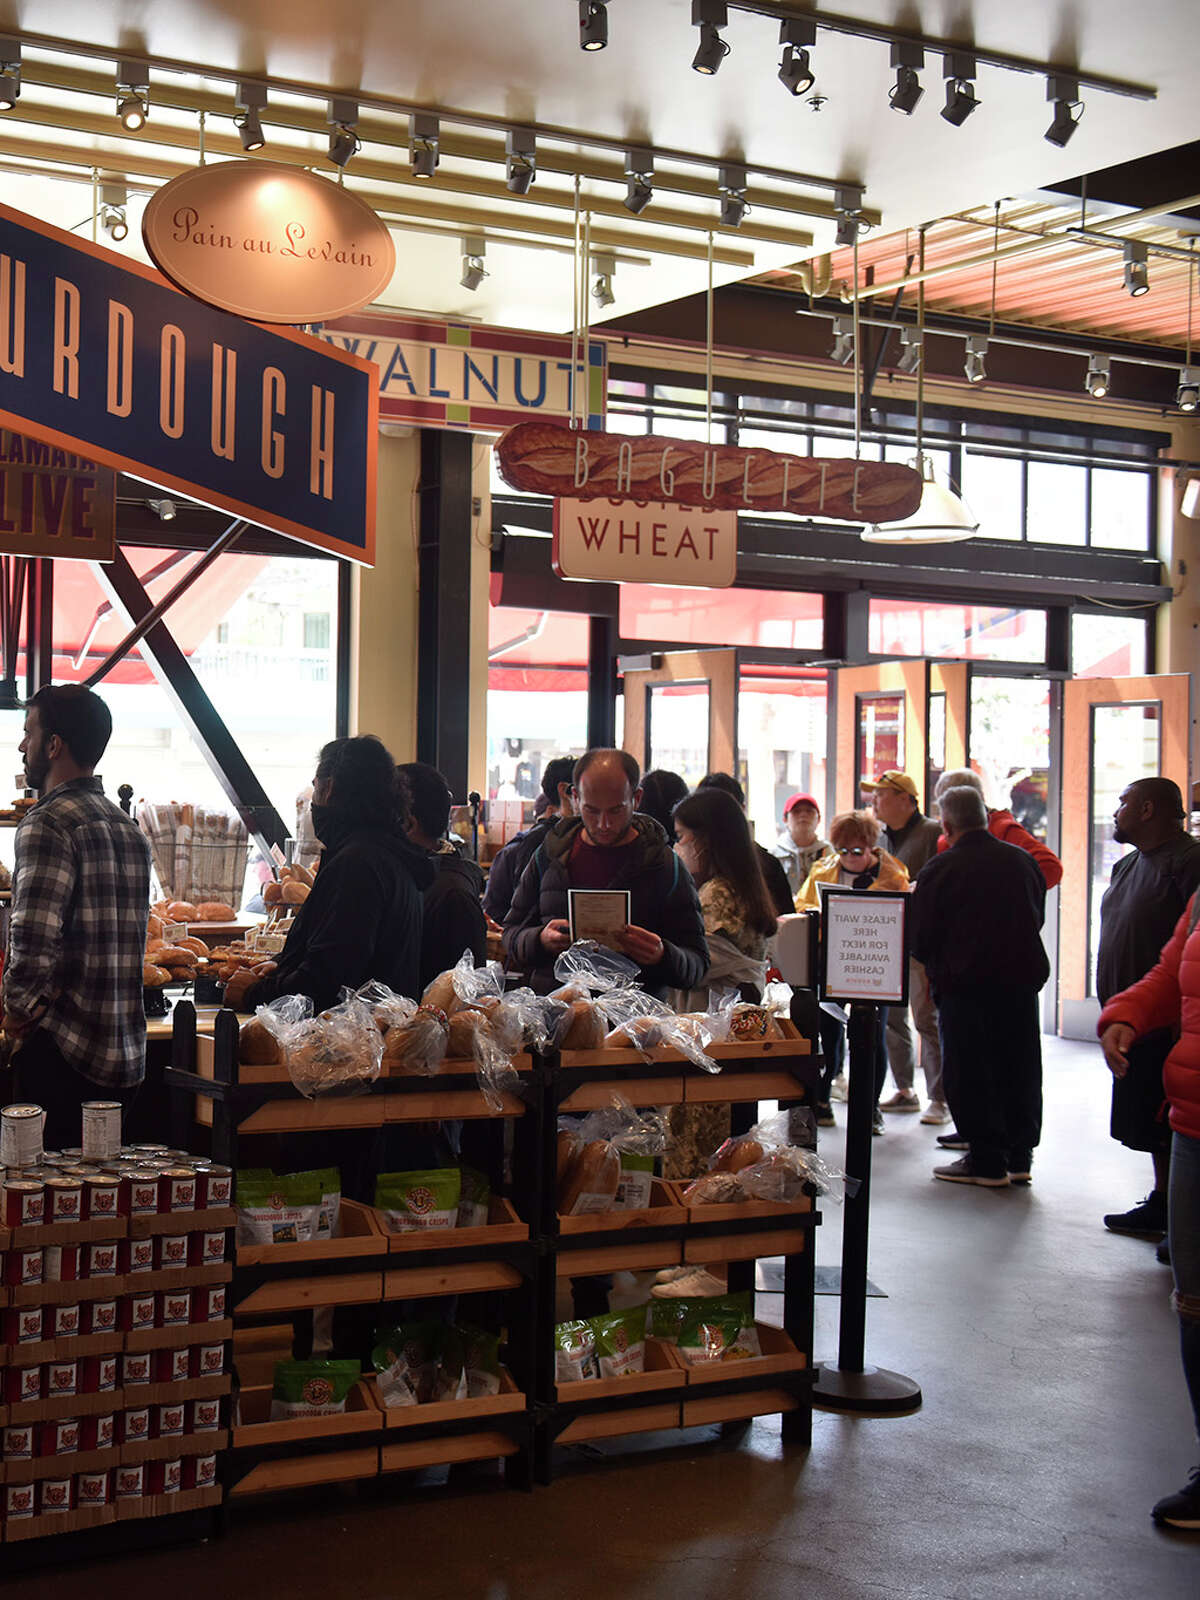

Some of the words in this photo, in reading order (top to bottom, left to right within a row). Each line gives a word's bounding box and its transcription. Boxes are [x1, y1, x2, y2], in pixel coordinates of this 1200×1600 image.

[173, 206, 236, 249] Pain
[243, 237, 273, 255] au
[280, 221, 378, 269] Levain
[326, 335, 585, 412] ALNUT
[574, 437, 866, 514] BAGUETTE
[577, 516, 720, 561] WHEAT
